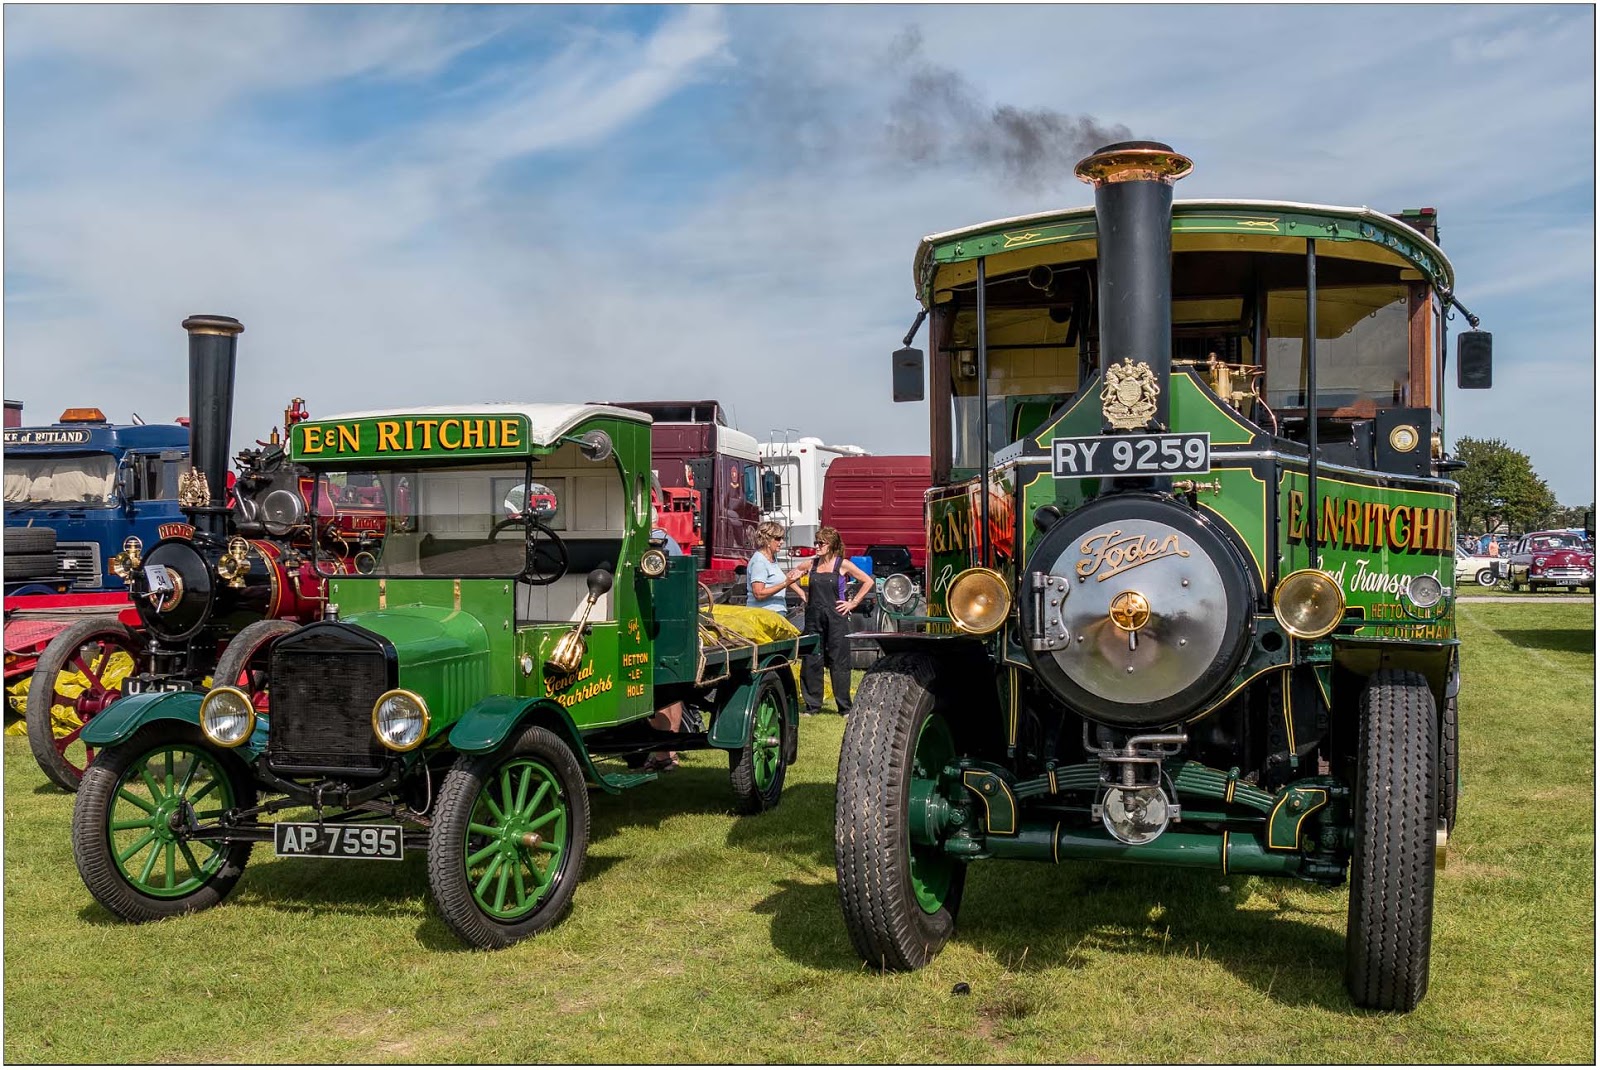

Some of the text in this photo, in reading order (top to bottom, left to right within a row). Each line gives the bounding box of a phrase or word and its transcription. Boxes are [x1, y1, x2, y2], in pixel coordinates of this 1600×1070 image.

[21, 433, 32, 443] of
[35, 431, 84, 442] RUTLAND
[377, 419, 521, 451] RITCHIE
[1056, 438, 1206, 473] RY 9259
[1075, 529, 1191, 582] Foden
[156, 575, 167, 587] 34
[622, 652, 649, 668] HETTON
[543, 659, 595, 698] General
[627, 685, 644, 698] HOLE
[283, 827, 396, 856] AP 7595
